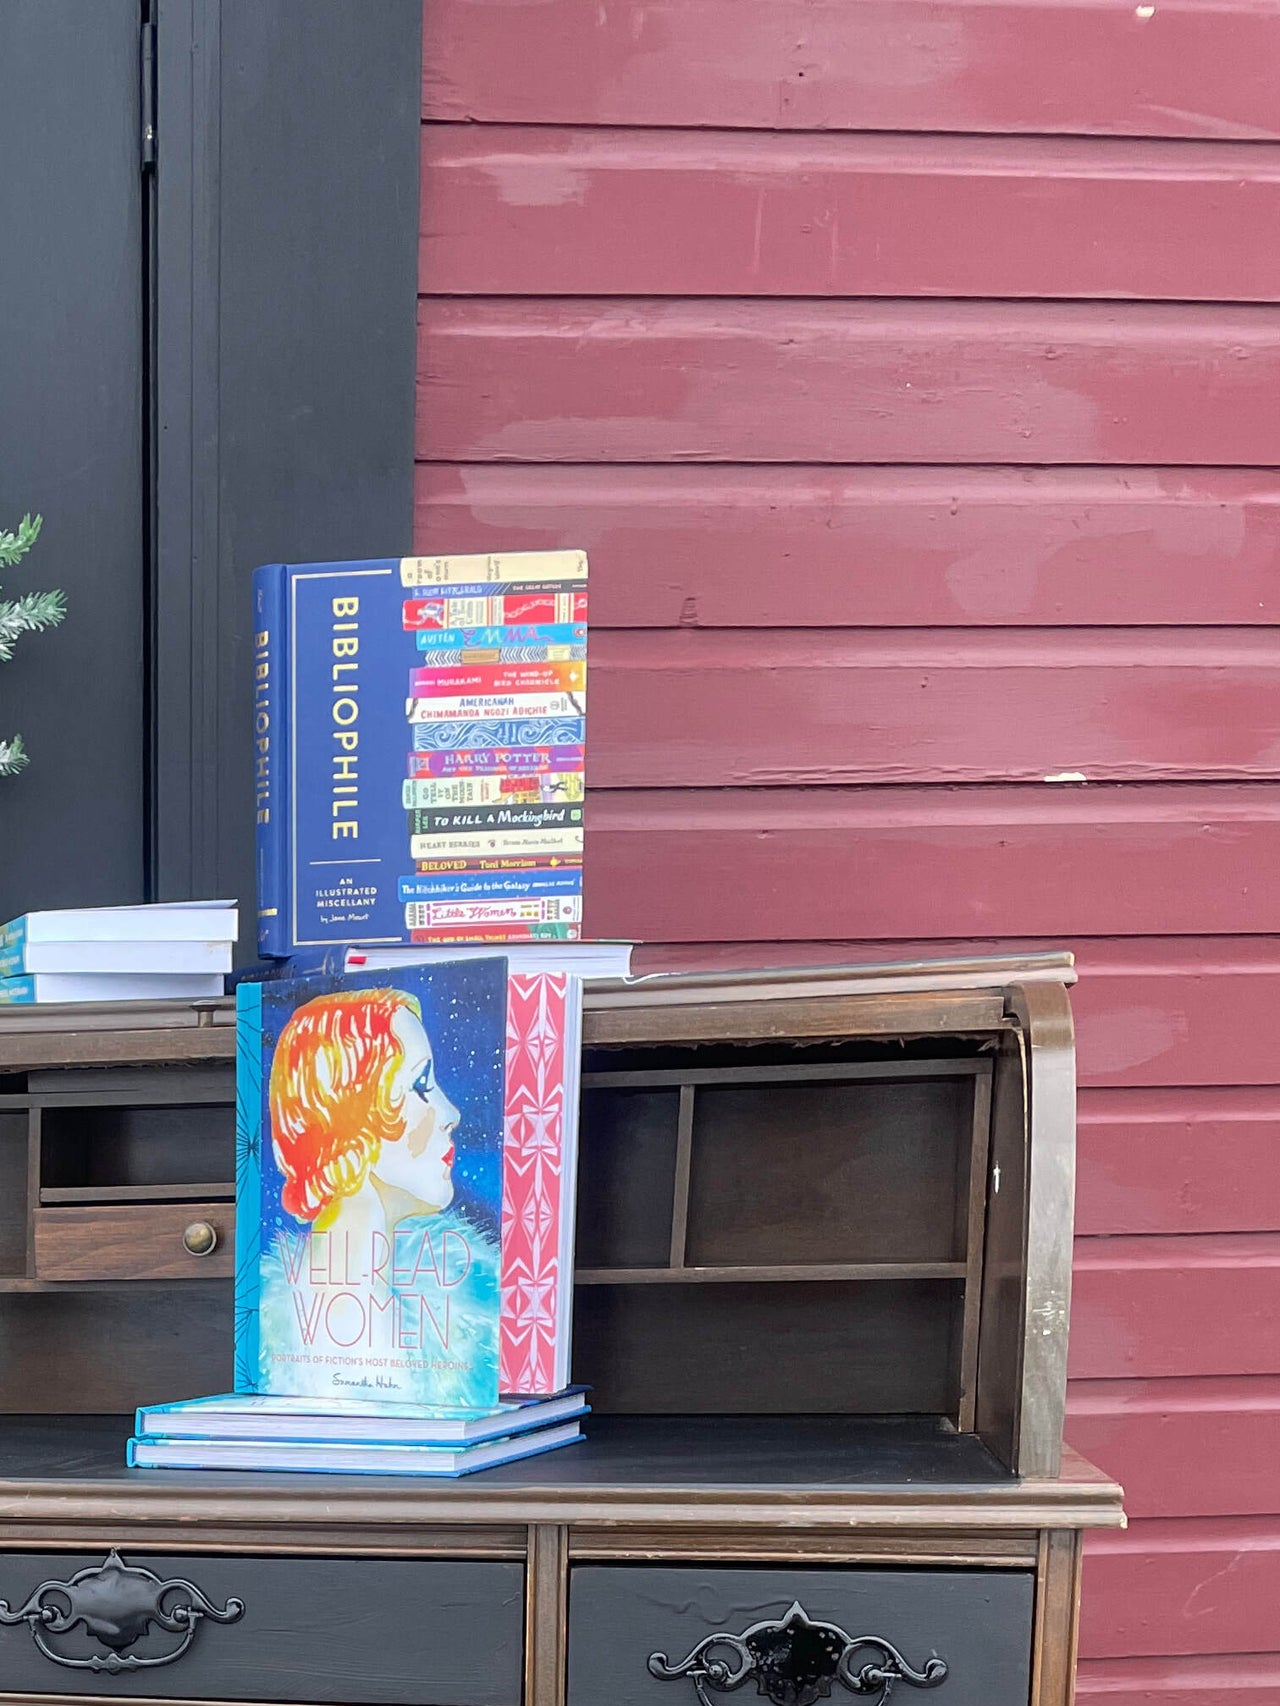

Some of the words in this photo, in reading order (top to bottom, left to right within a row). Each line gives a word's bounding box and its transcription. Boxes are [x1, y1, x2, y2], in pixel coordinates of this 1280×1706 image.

[421, 633, 454, 645] AUSTEN
[459, 697, 514, 708] AMERICANAH
[332, 597, 360, 839] BIBLIOPHILE
[421, 708, 480, 720] CHIMAMANDA
[484, 707, 509, 717] NGOZI
[512, 705, 548, 716] ADICHIE
[256, 630, 270, 825] BIBLIOPHILE
[444, 752, 490, 765] HARRY
[494, 752, 552, 765] POTTER
[434, 816, 449, 826] TO
[452, 814, 482, 826] KILL
[486, 815, 494, 824] A
[497, 808, 566, 827] Mockingbird
[421, 860, 467, 871] BELOVED
[479, 860, 498, 870] Toni
[339, 878, 353, 886] AN
[402, 884, 415, 894] The
[460, 882, 482, 893] Guide
[504, 880, 530, 892] Galaxy
[315, 886, 378, 898] ILLUSTRATED
[316, 898, 376, 908] MISCELLANY
[432, 908, 466, 921] Little
[467, 906, 516, 920] Women
[276, 1230, 471, 1287] WELL-READ
[292, 1291, 450, 1350] WOMEN
[272, 1354, 310, 1364] PORTRAITS
[313, 1356, 323, 1364] OF
[325, 1356, 363, 1367] FICTION'S
[366, 1358, 388, 1368] MOST
[390, 1359, 429, 1370] BELOVED
